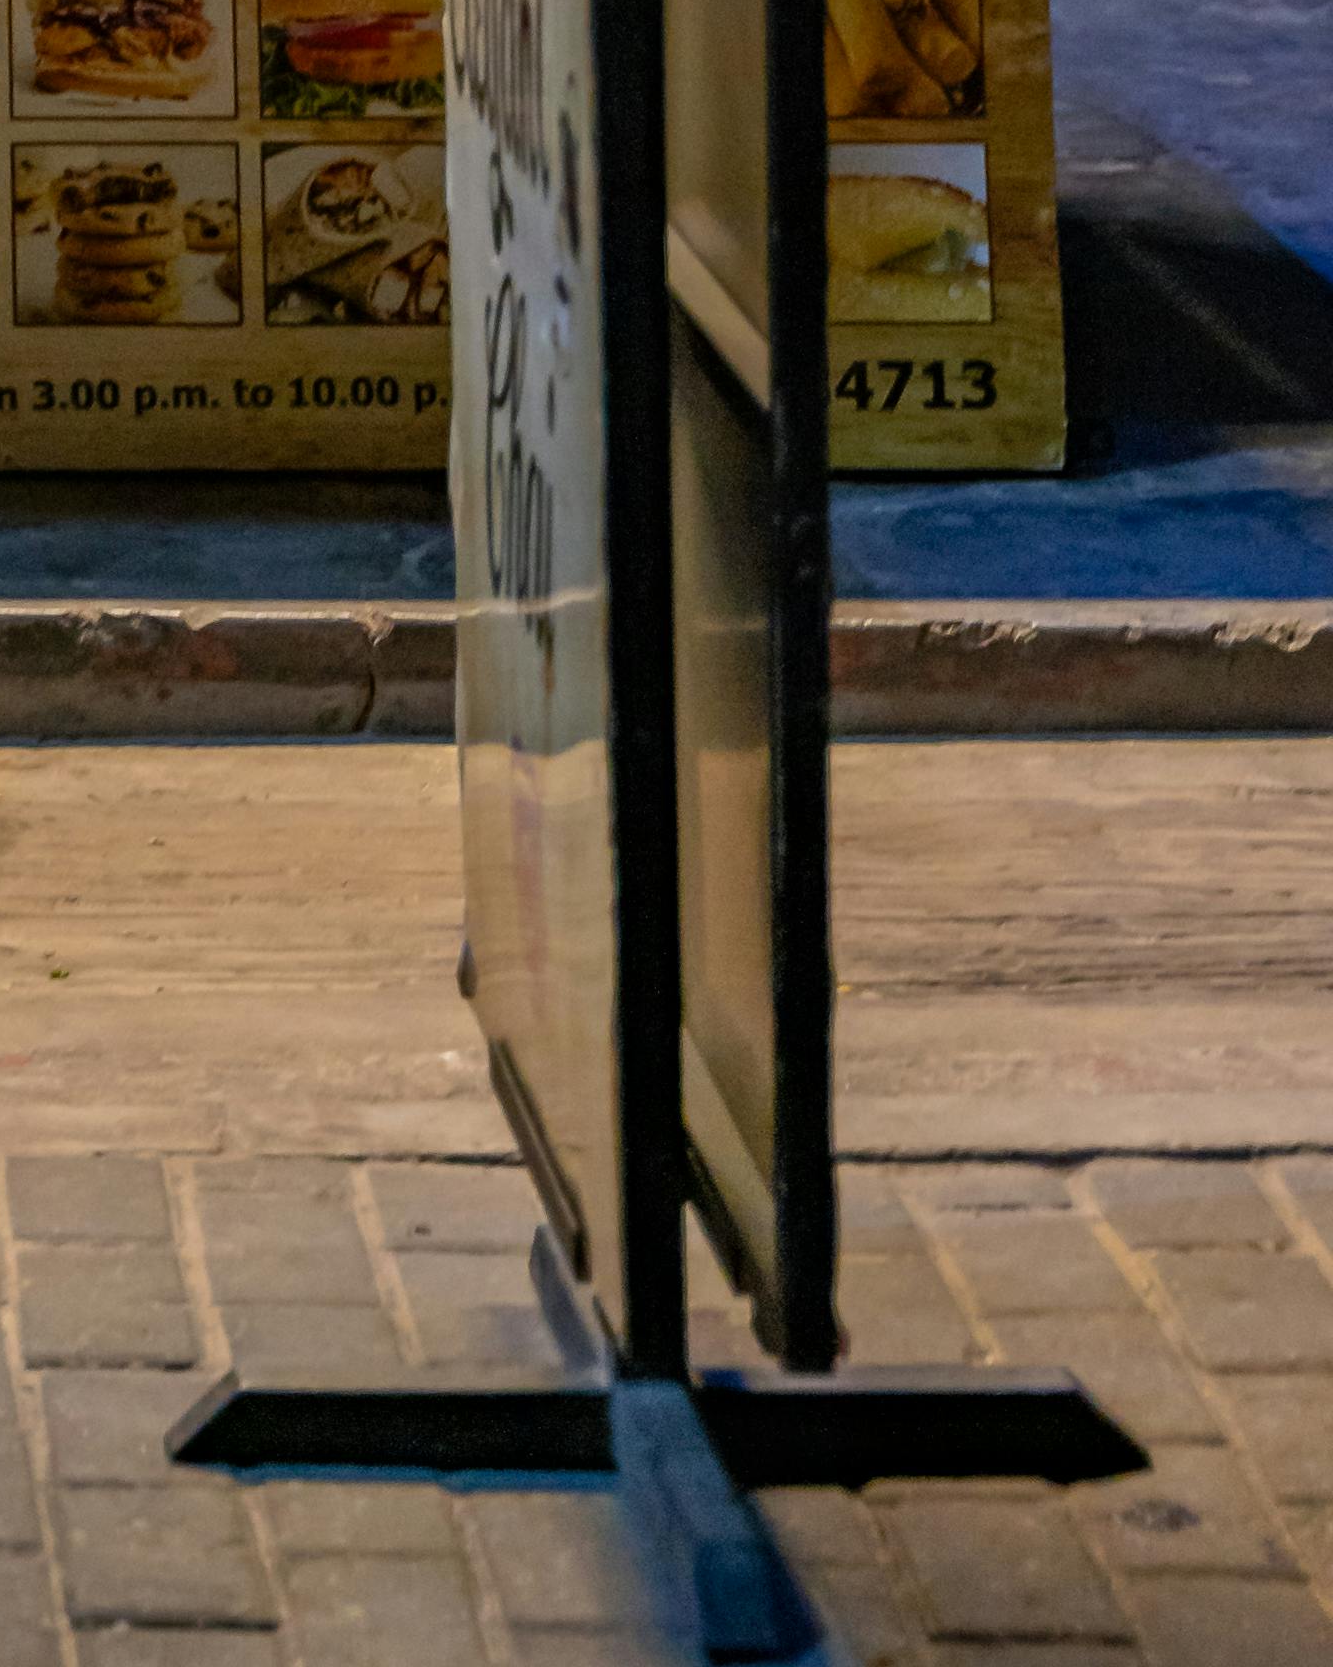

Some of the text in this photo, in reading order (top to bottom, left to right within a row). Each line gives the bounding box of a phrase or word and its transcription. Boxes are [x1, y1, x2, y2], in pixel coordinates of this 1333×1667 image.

[31, 375, 121, 412] 3.00
[133, 381, 221, 420] p.m.
[232, 376, 275, 410] to
[288, 373, 400, 410] 10.00
[834, 360, 1000, 413] 4713
